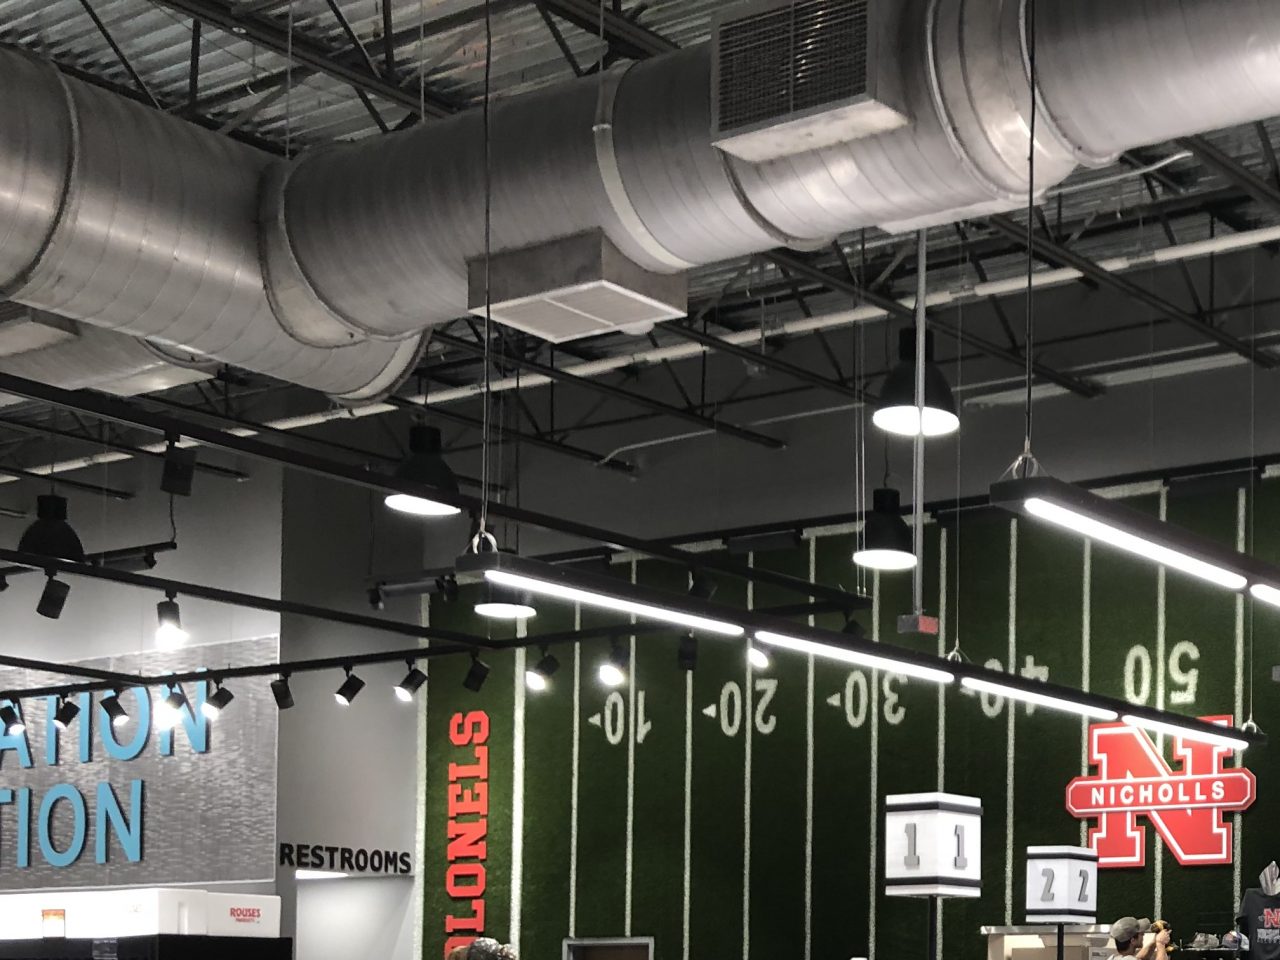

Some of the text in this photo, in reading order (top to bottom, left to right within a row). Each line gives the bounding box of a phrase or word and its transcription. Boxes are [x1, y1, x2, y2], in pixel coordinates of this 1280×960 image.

[1124, 640, 1200, 705] 50
[604, 690, 652, 745] 10
[719, 678, 778, 737] 20
[1091, 780, 1226, 806] NICHOLLS
[0, 779, 143, 868] ION
[903, 822, 921, 868] 1
[280, 843, 412, 875] RESTROOMS
[953, 824, 969, 869] 1
[1041, 868, 1055, 902] 2
[1078, 869, 1090, 902] 2
[230, 907, 261, 918] ROUSES
